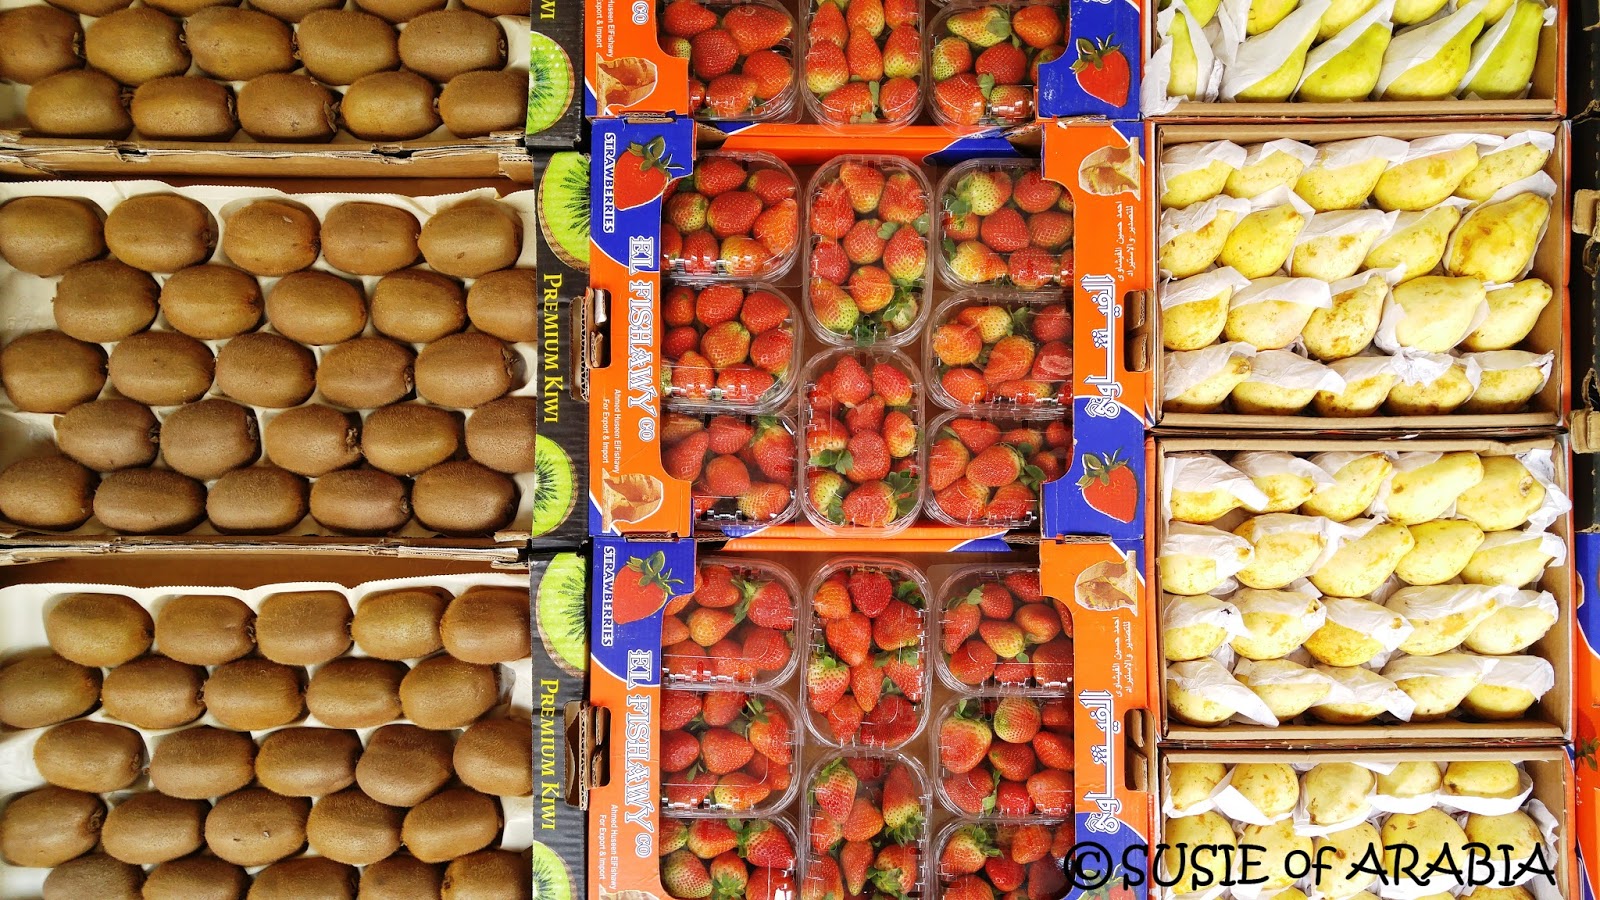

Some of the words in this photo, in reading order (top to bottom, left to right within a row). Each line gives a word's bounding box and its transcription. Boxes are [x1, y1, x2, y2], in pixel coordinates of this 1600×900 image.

[595, 26, 604, 48] Import
[603, 133, 616, 233] STRAWBERRIES
[629, 236, 654, 276] EL
[543, 273, 562, 371] PREMIUM
[628, 280, 657, 417] FISHAWY
[543, 375, 564, 423] KIWI
[602, 399, 610, 411] For
[614, 389, 622, 412] Ahmed
[601, 412, 610, 434] Export
[614, 413, 622, 438] Huseen
[601, 442, 610, 463] Import
[602, 546, 615, 647] STRAWBERRIES
[627, 649, 653, 691] EL
[540, 678, 560, 776] PREMIUM
[624, 694, 655, 833] FISHAWY
[540, 781, 560, 830] KIWI
[610, 804, 619, 828] Ahmed
[599, 814, 607, 826] For
[598, 827, 607, 850] Export
[610, 829, 619, 855] Huseen
[598, 857, 607, 880] Import
